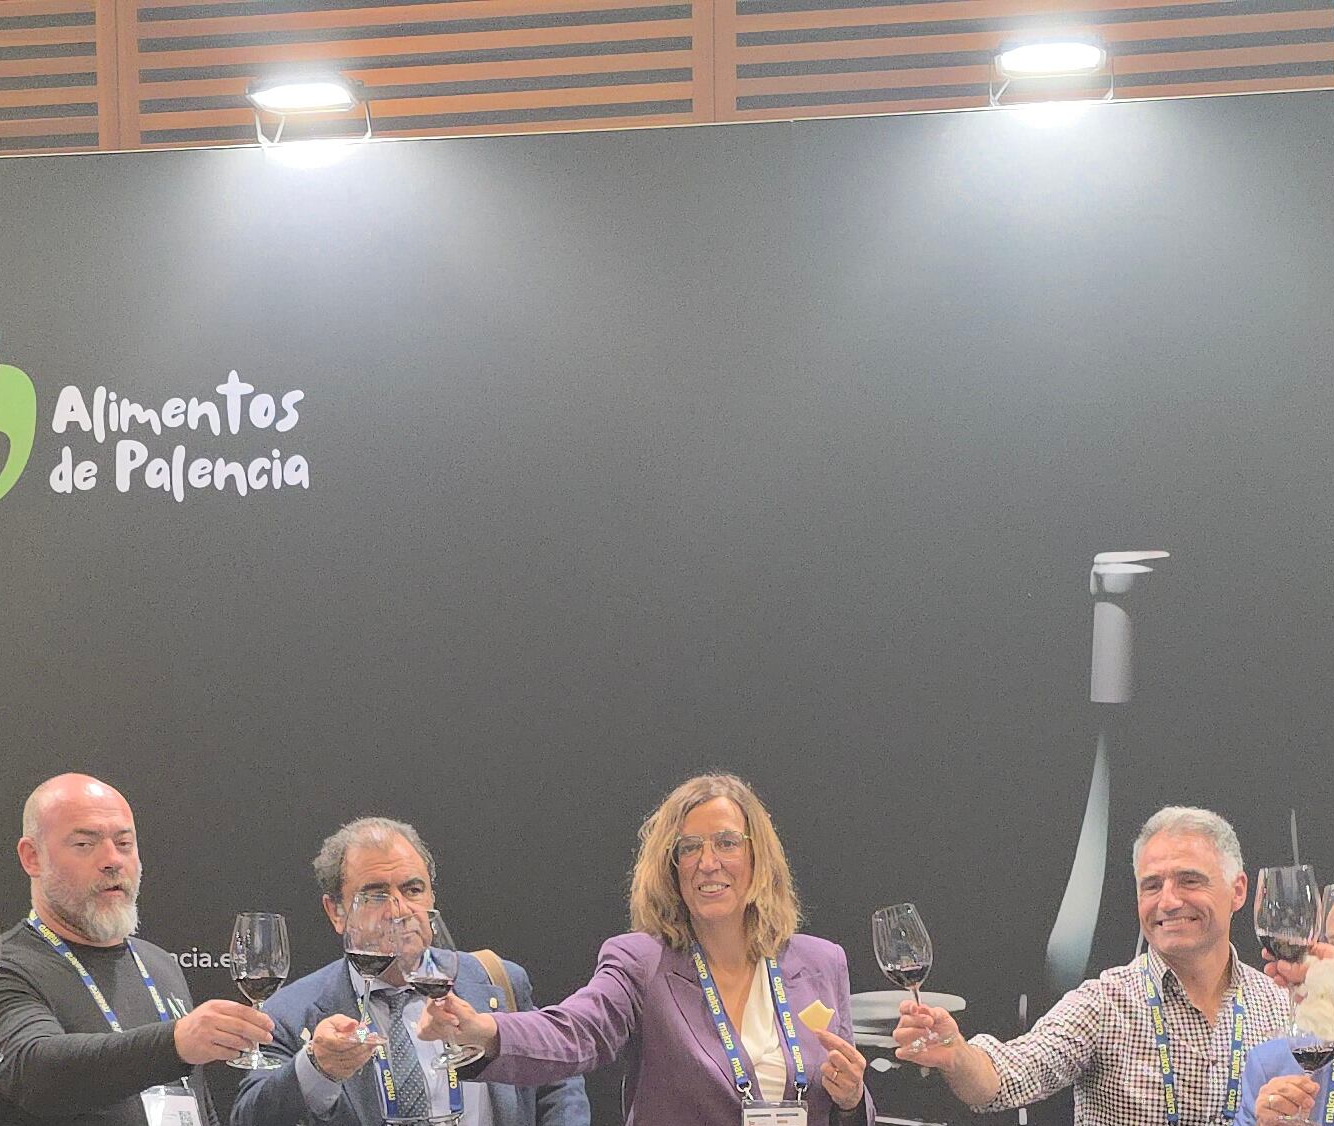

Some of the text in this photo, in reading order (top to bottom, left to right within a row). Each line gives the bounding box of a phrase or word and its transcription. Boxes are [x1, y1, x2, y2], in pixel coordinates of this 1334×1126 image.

[52, 369, 304, 443] Alimentos
[49, 439, 309, 502] de Palencia
[705, 986, 721, 1015] makro
[718, 1022, 734, 1050] makro
[731, 1057, 745, 1078] mak
[1158, 1043, 1170, 1075] makro
[1231, 1049, 1241, 1080] makro
